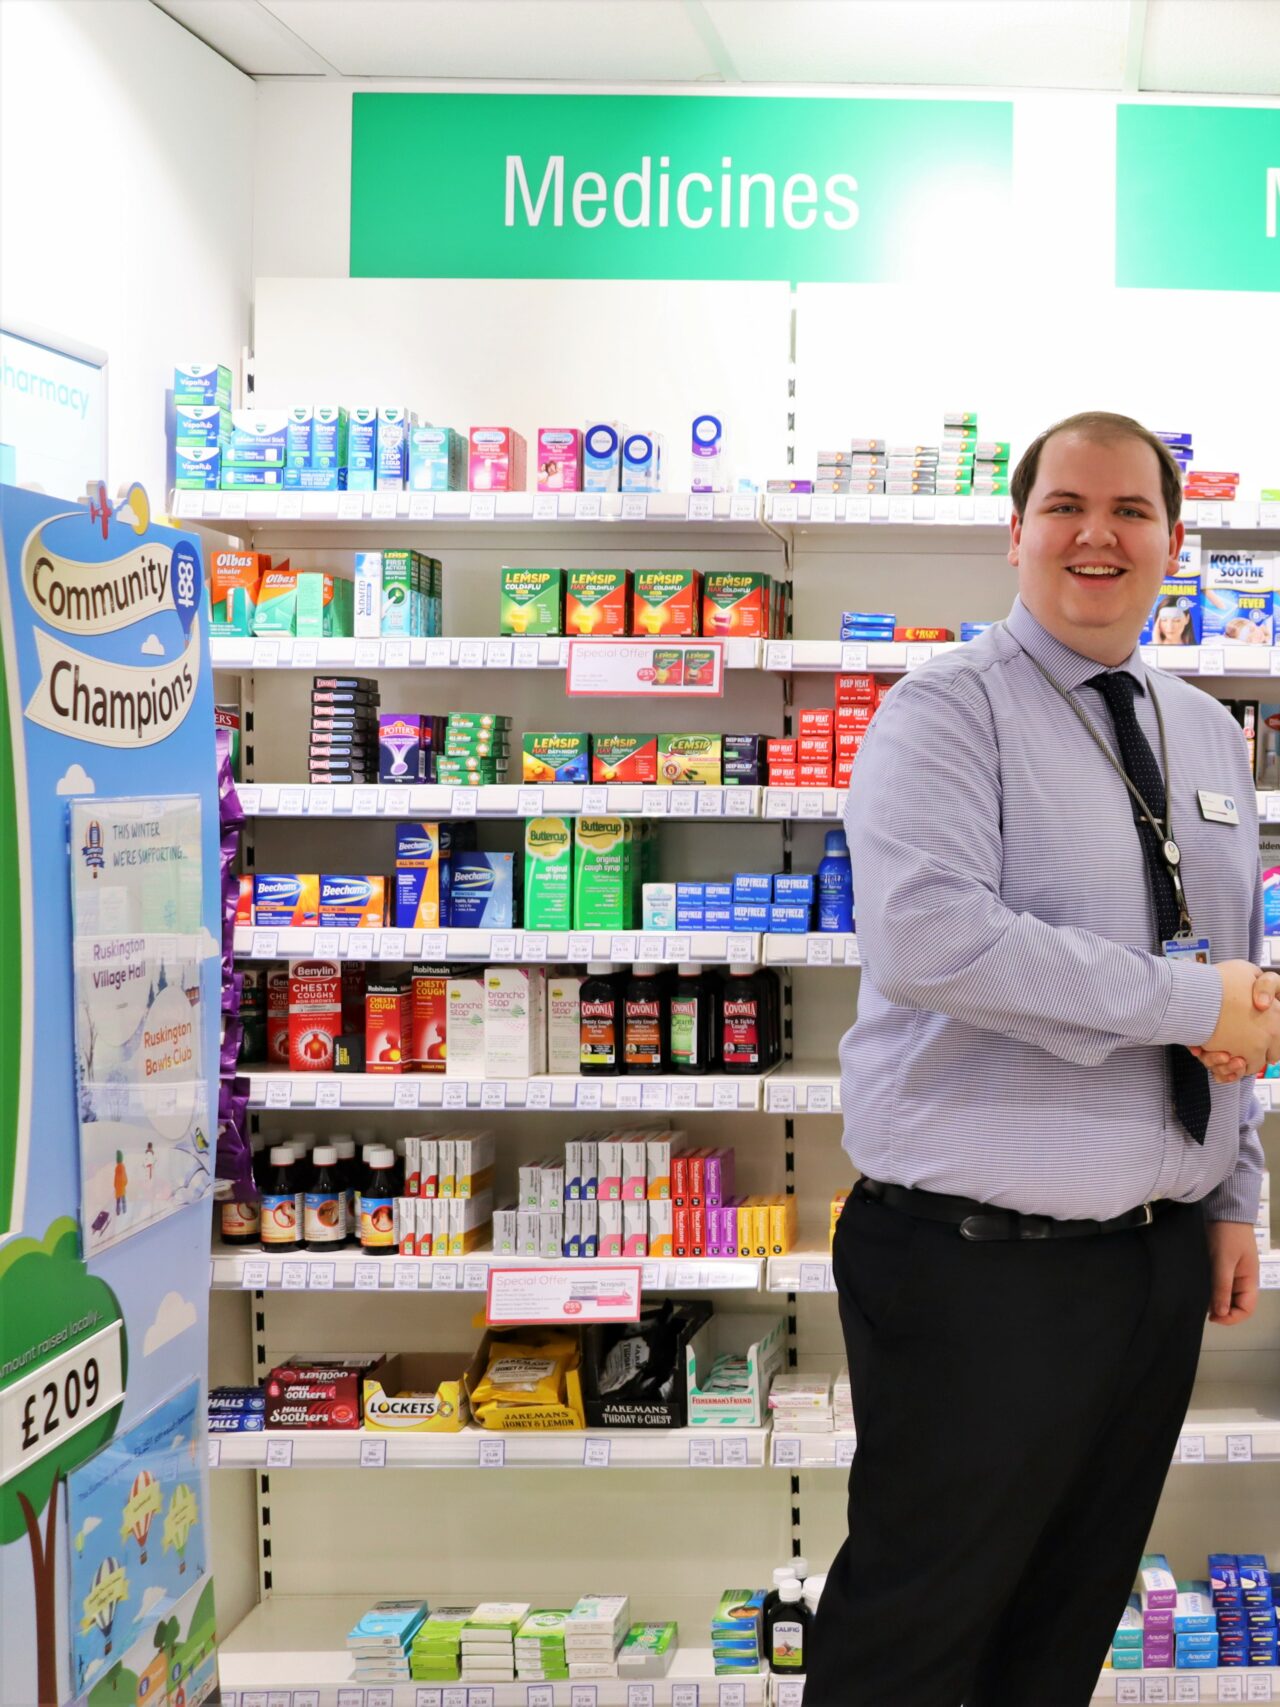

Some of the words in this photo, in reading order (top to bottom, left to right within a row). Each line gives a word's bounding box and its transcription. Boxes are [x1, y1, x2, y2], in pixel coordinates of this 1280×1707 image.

[505, 155, 860, 229] Medicines
[217, 553, 252, 567] Olbas
[1220, 568, 1264, 578] SOOTHE
[266, 574, 296, 584] Olbas
[506, 573, 550, 585] LEMSIP
[572, 574, 616, 586] LEMSIP
[639, 574, 684, 586] LEMSIP
[32, 555, 169, 620] Community
[1239, 598, 1266, 608] FEVER
[576, 648, 618, 660] Special
[620, 648, 651, 658] Offer
[840, 678, 854, 688] DEEP
[855, 678, 870, 688] HEAT
[50, 658, 194, 738] Champions
[838, 707, 853, 716] DEEP
[854, 707, 868, 716] HEAT
[802, 714, 815, 723] DEEP
[816, 714, 828, 723] HEAT
[533, 738, 580, 749] LEMSIP
[113, 824, 130, 839] THIS
[131, 822, 160, 838] WINTER
[581, 821, 622, 835] Buttercup
[530, 831, 568, 844] Buttercup
[399, 842, 429, 851] Beechams
[113, 849, 137, 866] WE'RE
[455, 872, 490, 882] Beechams
[258, 883, 297, 894] Beechams
[736, 878, 750, 889] DEEP
[750, 878, 768, 889] FREEZE
[777, 879, 790, 889] DEEP
[791, 879, 809, 889] FREEZE
[323, 886, 368, 896] Beechams
[93, 939, 145, 960] Ruskington
[298, 966, 334, 977] Benylin
[414, 966, 450, 974] Robitussin
[93, 968, 127, 990] Village
[128, 964, 146, 981] Hall
[293, 983, 337, 993] CHESTY
[368, 985, 398, 993] Robitussin
[416, 980, 446, 988] CHESTY
[416, 988, 446, 996] COUGH
[488, 992, 525, 1000] broncho
[488, 999, 509, 1008] stop
[671, 1002, 695, 1016] COVONIA
[582, 1002, 614, 1017] COVONIA
[626, 1002, 659, 1017] COVONIA
[724, 1002, 756, 1017] COVONIA
[144, 1022, 192, 1048] Ruskington
[146, 1055, 171, 1076] Bowls
[173, 1048, 192, 1066] Club
[497, 1275, 536, 1286] Special
[540, 1275, 568, 1285] Offer
[22, 1357, 100, 1451] £209
[692, 1397, 731, 1405] FISHERMAN'S
[732, 1396, 752, 1404] FRIEND
[370, 1402, 434, 1414] LOCKETS
[604, 1405, 668, 1414] JAKEMANS
[270, 1408, 329, 1423] Soothers
[504, 1412, 568, 1420] JAKEMANS
[602, 1414, 636, 1425] THROAT
[637, 1414, 643, 1424] &
[644, 1414, 672, 1424] CHEST
[502, 1420, 532, 1428] HONEY
[534, 1420, 540, 1428] &
[542, 1419, 575, 1428] LEMON
[774, 1626, 800, 1634] CALIFIG
